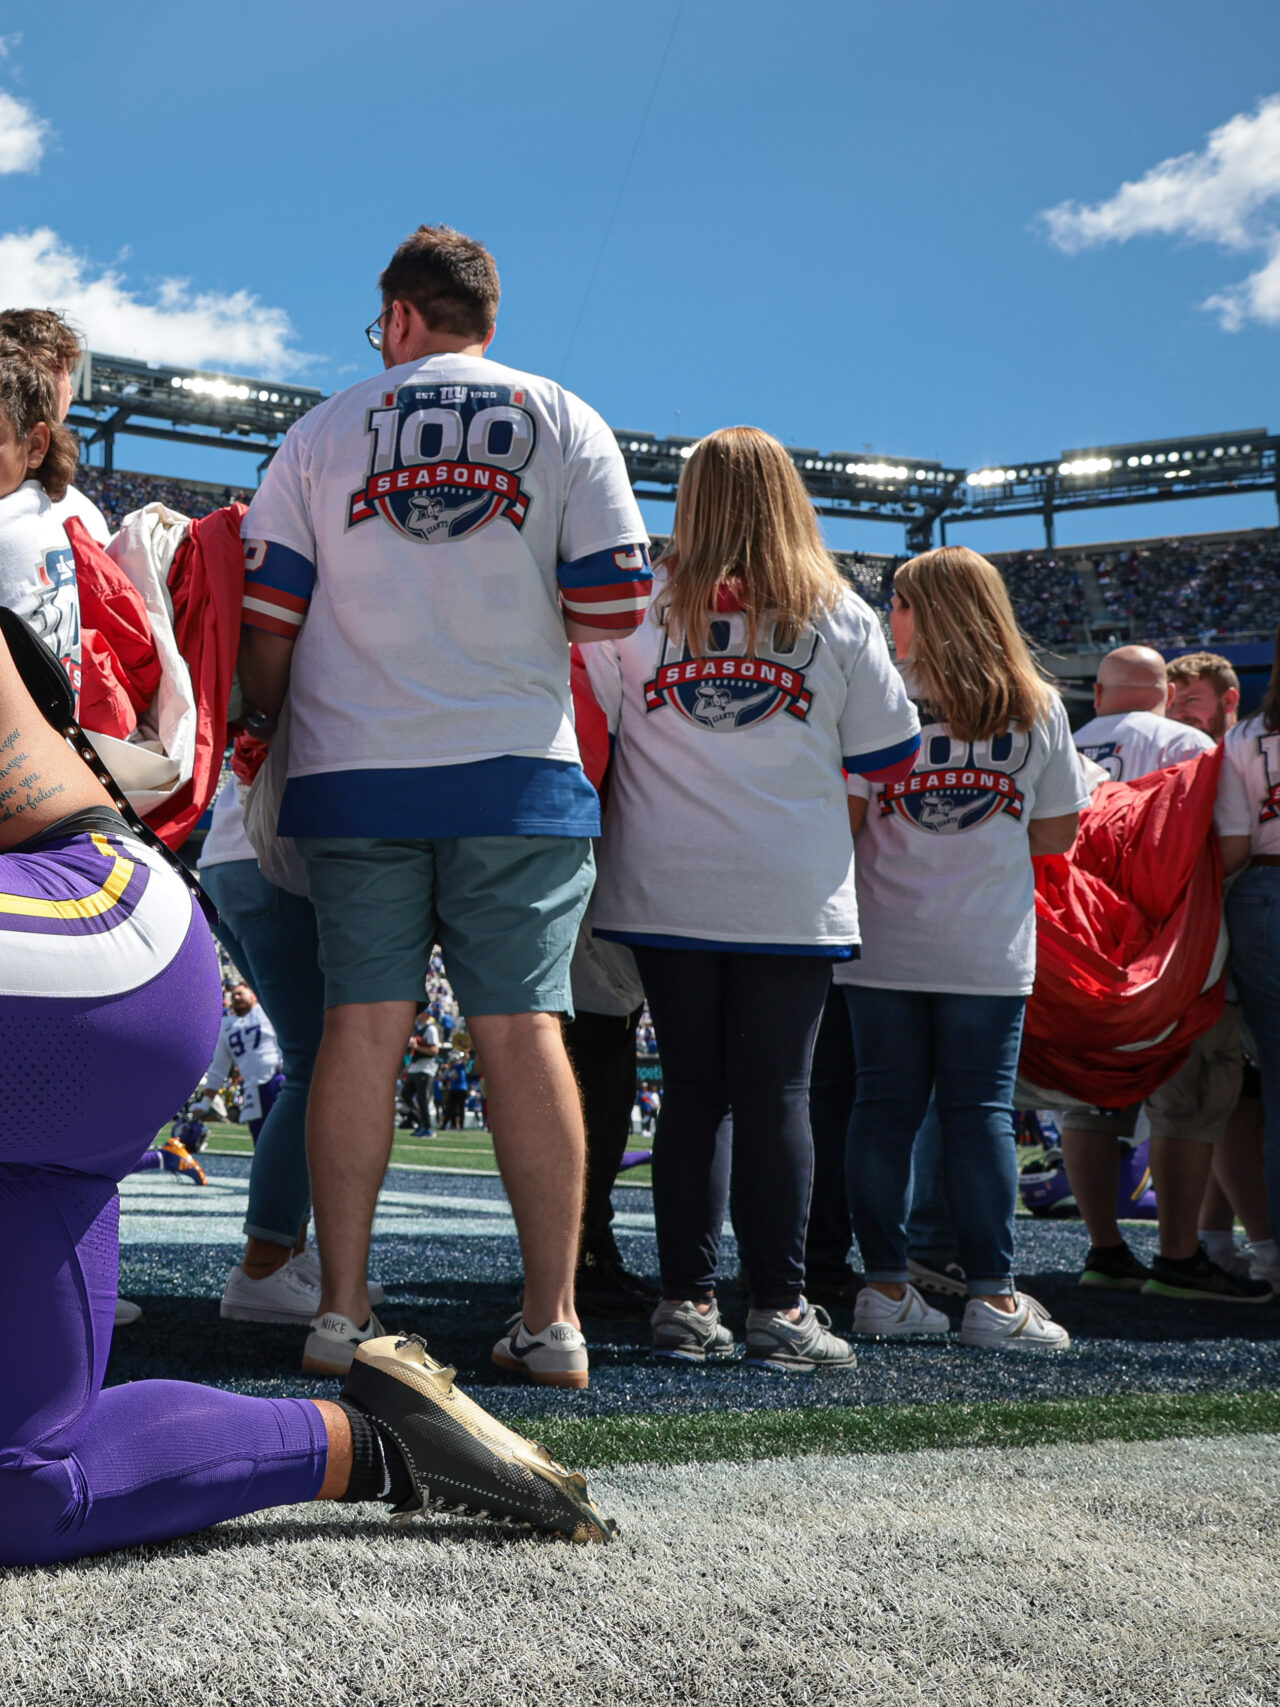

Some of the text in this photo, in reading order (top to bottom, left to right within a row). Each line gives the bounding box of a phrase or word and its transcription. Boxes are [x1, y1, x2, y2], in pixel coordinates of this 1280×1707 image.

[470, 391, 498, 399] 1925
[370, 406, 535, 474] 100
[376, 466, 509, 492] SEASONS
[425, 520, 450, 535] GIANTS
[666, 661, 794, 690] SEASONS
[893, 772, 1010, 795] SEASONS
[23, 783, 65, 810] future
[227, 1024, 262, 1058] 97
[320, 1319, 347, 1335] NIKE
[549, 1328, 577, 1342] NIKE
